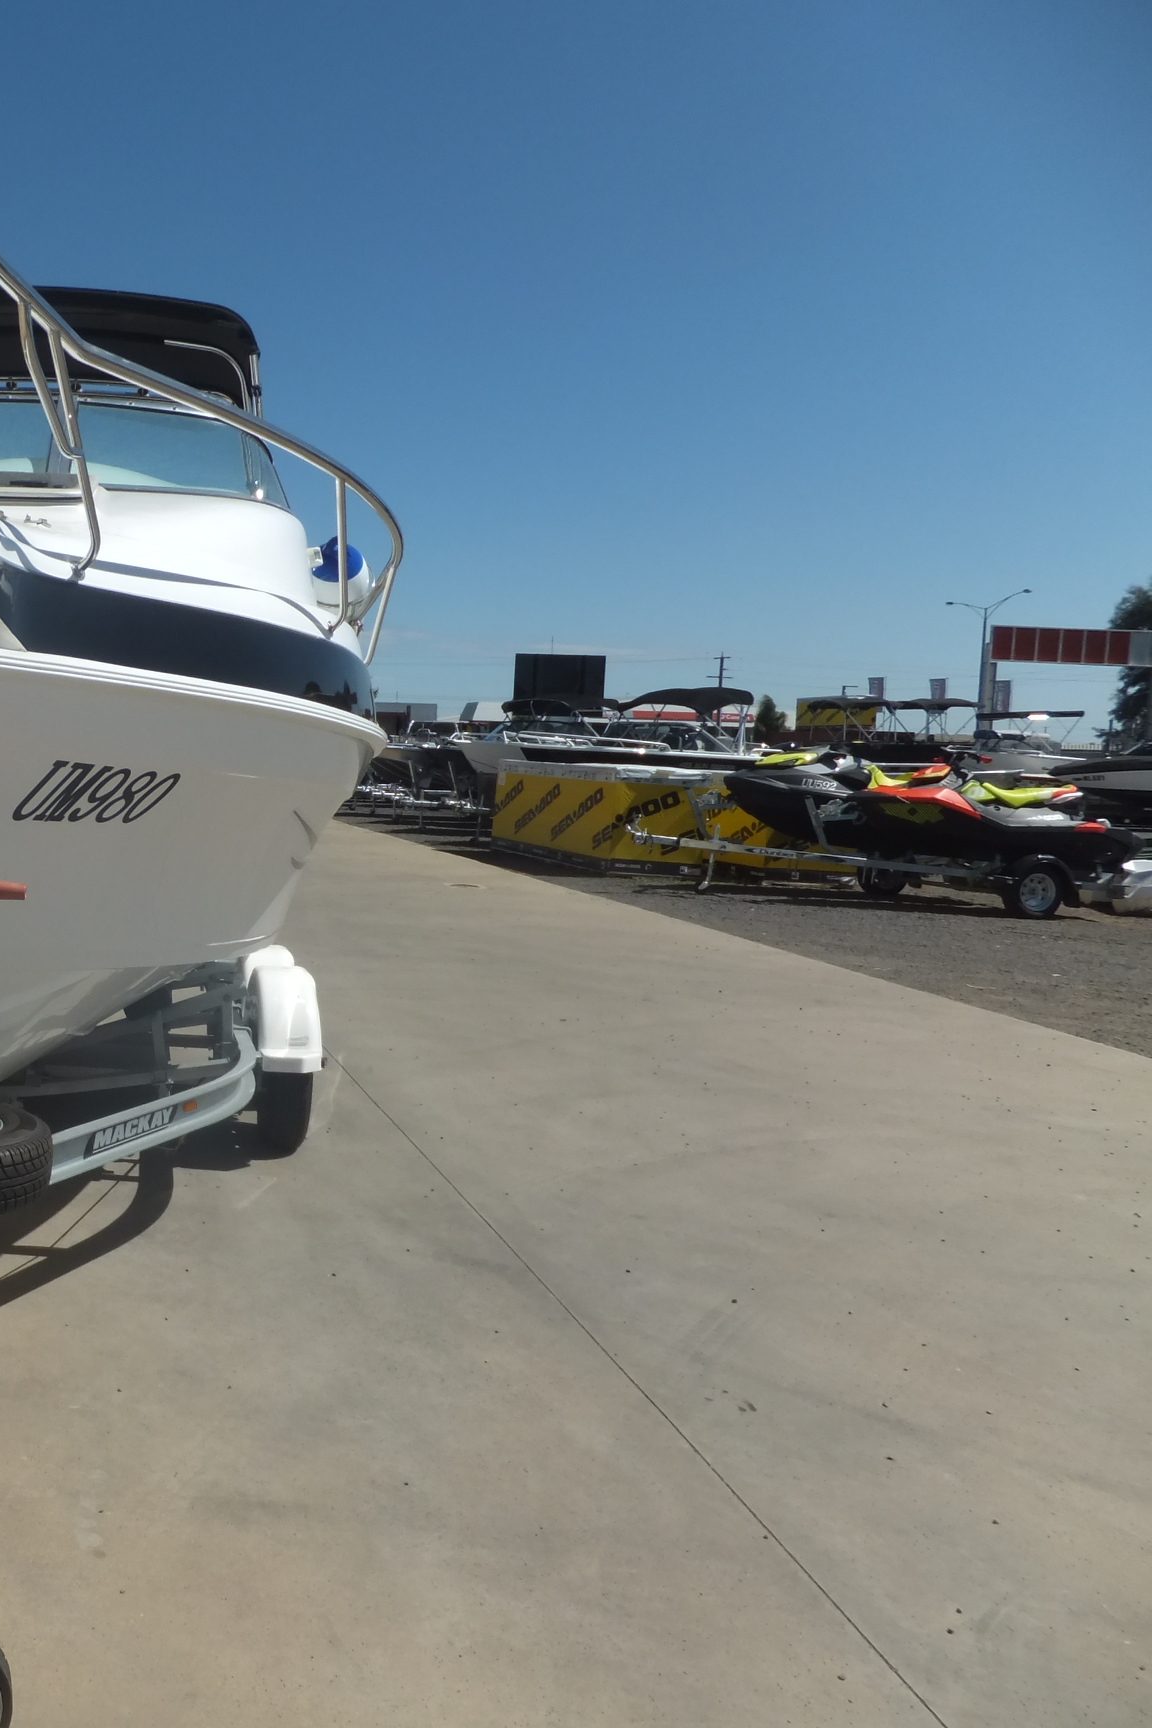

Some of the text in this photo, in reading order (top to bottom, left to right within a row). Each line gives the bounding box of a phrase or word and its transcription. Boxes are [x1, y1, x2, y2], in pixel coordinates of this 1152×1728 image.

[12, 760, 181, 823] UM980
[802, 778, 837, 791] UU592
[93, 1106, 174, 1150] MACKAY
